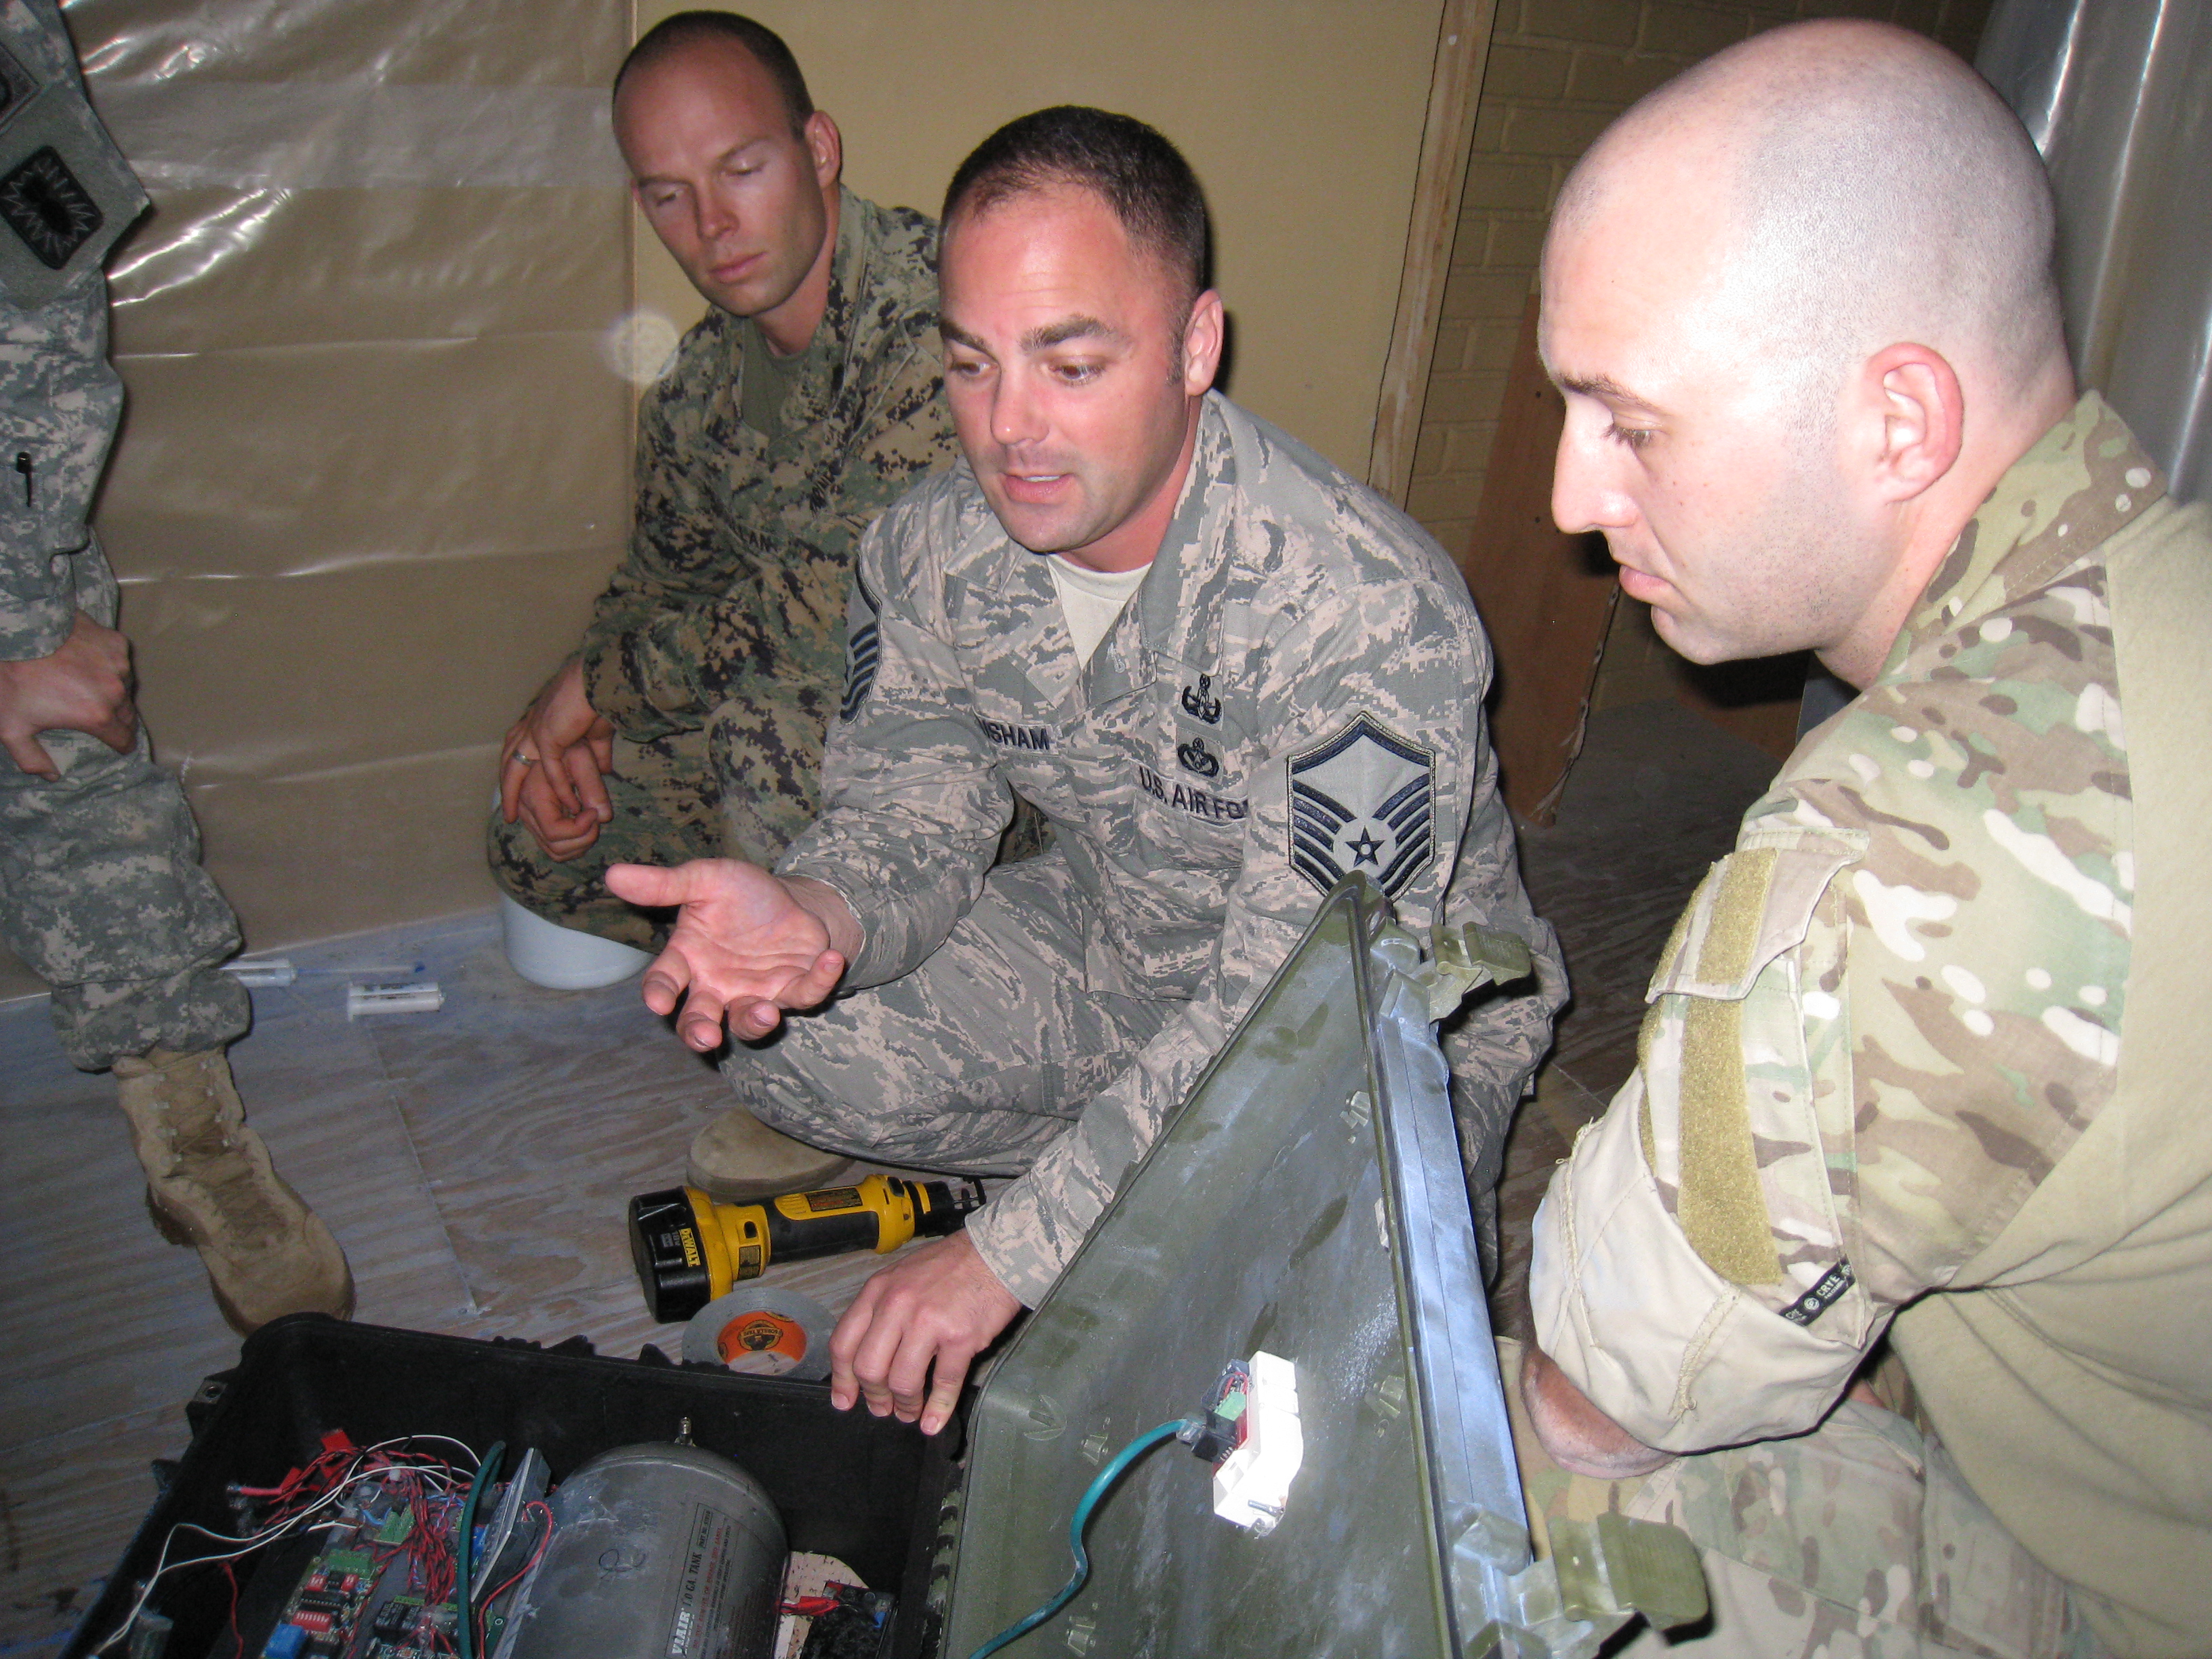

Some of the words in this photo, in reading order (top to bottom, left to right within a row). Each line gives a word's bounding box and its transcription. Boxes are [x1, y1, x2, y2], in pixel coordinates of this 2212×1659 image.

[1139, 766, 1168, 805] U.S.
[1172, 783, 1208, 816] AIR
[1816, 1275, 1841, 1296] CRYE
[672, 1611, 691, 1656] VIAIR
[689, 1552, 702, 1574] TANK
